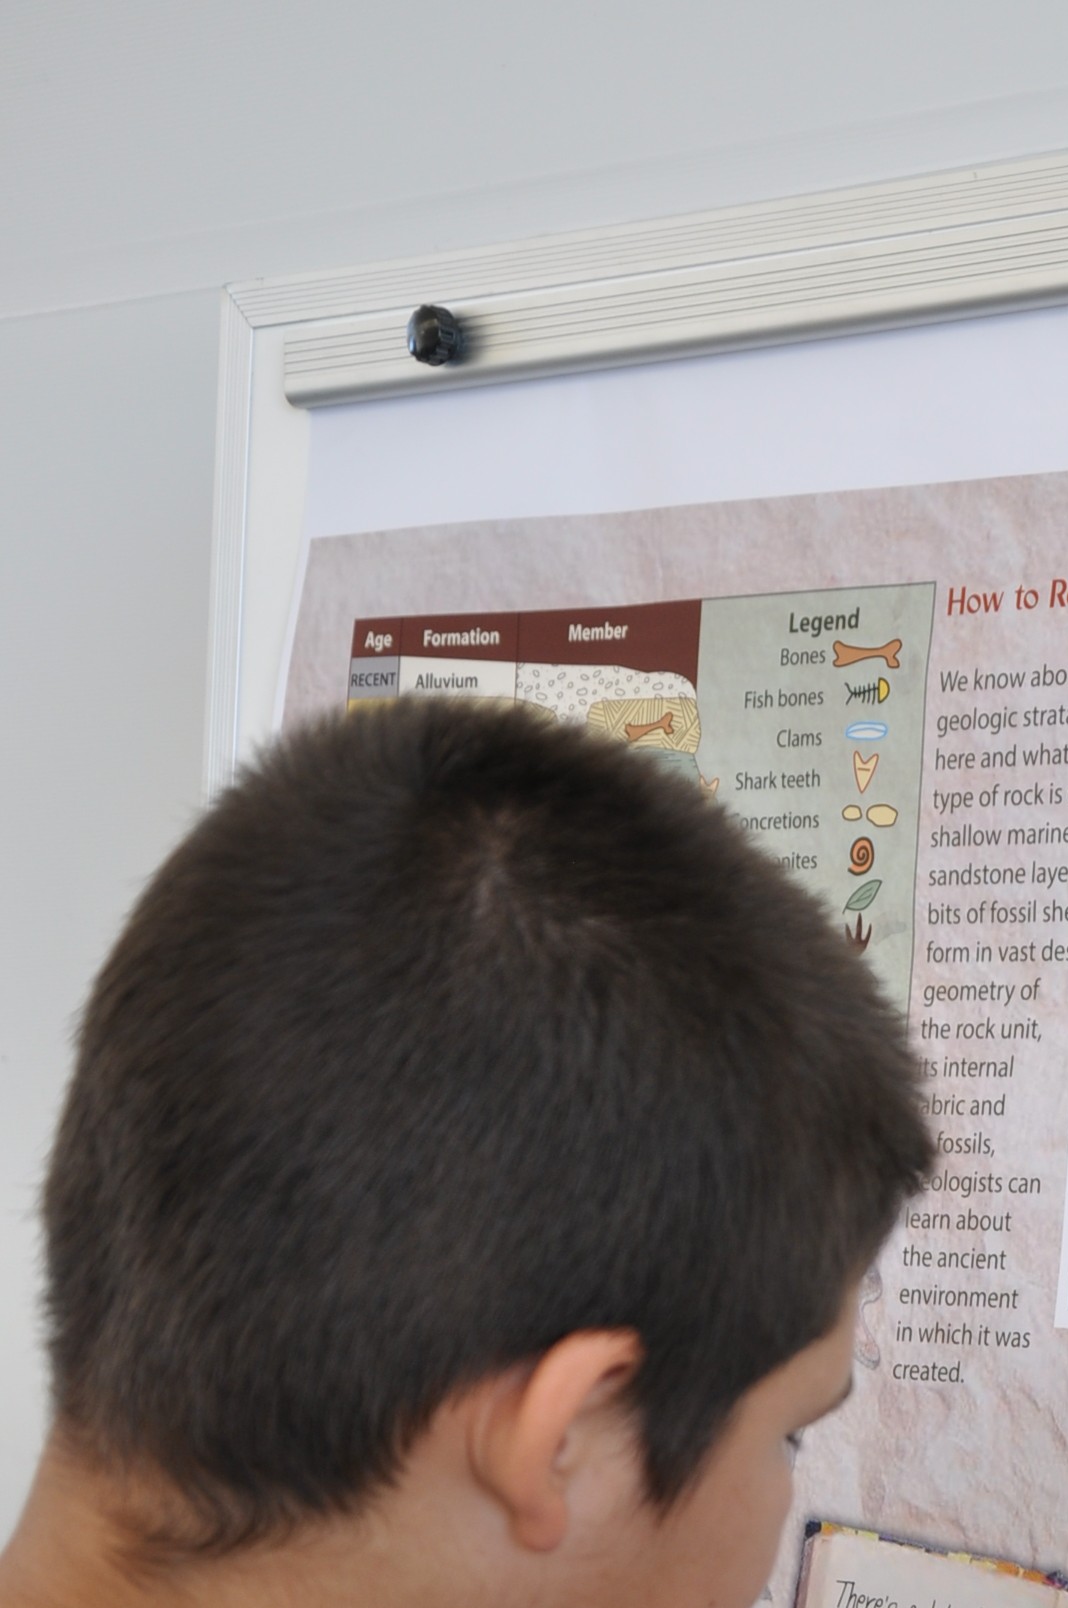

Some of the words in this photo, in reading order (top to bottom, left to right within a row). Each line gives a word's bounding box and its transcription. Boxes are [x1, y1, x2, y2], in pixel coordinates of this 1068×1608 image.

[947, 586, 1005, 617] How
[1015, 584, 1039, 611] to
[567, 621, 629, 643] Member
[788, 606, 861, 639] Legend
[364, 631, 394, 652] Age
[422, 627, 501, 648] Formation
[780, 647, 826, 667] Bones
[350, 671, 397, 687] RECENT
[415, 673, 479, 689] Alluvium
[940, 670, 969, 693] We
[973, 667, 1026, 691] know
[744, 689, 774, 709] Fish
[777, 688, 824, 708] bones
[936, 706, 1018, 739] geologic
[776, 728, 823, 748] Clams
[935, 747, 976, 771] here
[980, 743, 1017, 769] and
[735, 770, 778, 791] Shark
[780, 768, 821, 789] teeth
[933, 789, 974, 816] type
[978, 783, 1001, 808] of
[1003, 781, 1044, 807] rock
[1049, 782, 1063, 805] is
[734, 811, 821, 831] oncretions
[930, 823, 1003, 848] shallow
[928, 862, 1027, 887] sandstone
[927, 902, 961, 926] bits
[966, 900, 988, 925] of
[990, 899, 1037, 924] fossil
[926, 940, 970, 964] form
[975, 940, 993, 963] in
[998, 941, 1037, 963] vast
[923, 980, 1016, 1008] geometry
[1020, 976, 1042, 1001] of
[921, 1016, 951, 1040] the
[955, 1016, 996, 1040] rock
[1000, 1017, 1042, 1043] unit,
[943, 1054, 1015, 1078] internal
[920, 1093, 966, 1117] abric
[969, 1093, 1006, 1117] and
[937, 1131, 995, 1158] fossils,
[921, 1173, 1002, 1198] eologists
[1007, 1176, 1041, 1195] can
[904, 1205, 952, 1233] learn
[955, 1207, 1013, 1233] about
[902, 1244, 933, 1268] the
[936, 1247, 1007, 1271] ancient
[899, 1284, 1020, 1310] environment
[896, 1320, 913, 1343] in
[918, 1321, 973, 1346] which
[977, 1324, 991, 1347] it
[995, 1330, 1031, 1349] was
[892, 1360, 965, 1384] created.
